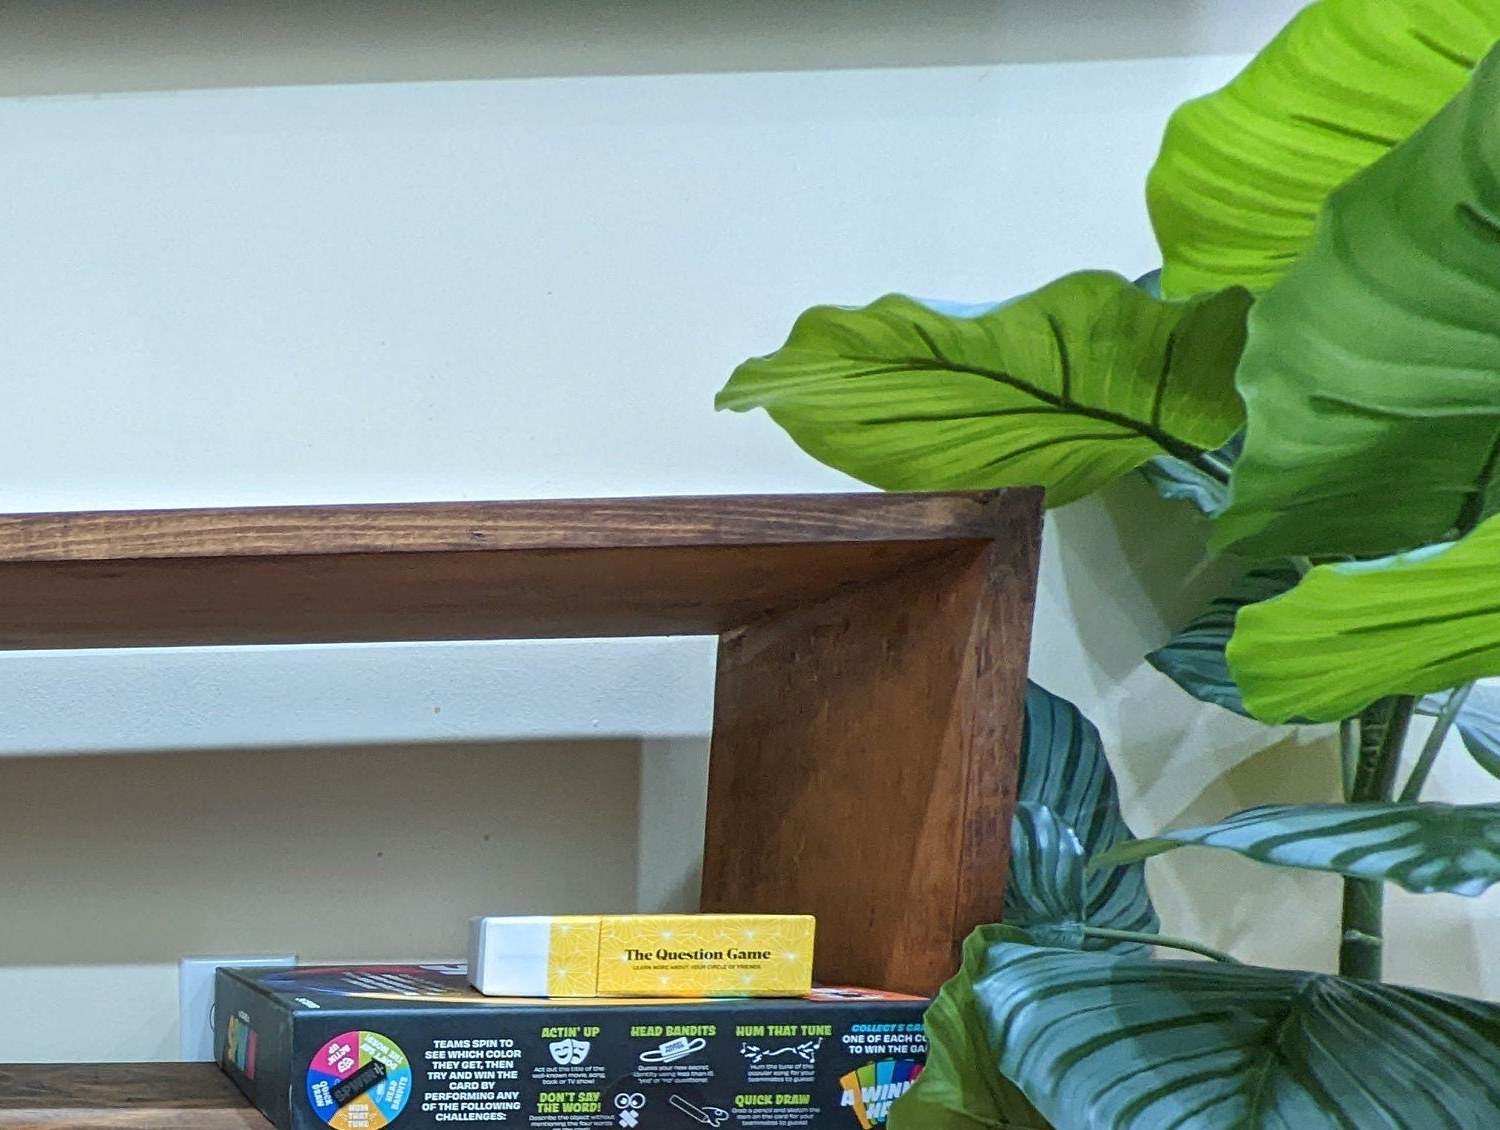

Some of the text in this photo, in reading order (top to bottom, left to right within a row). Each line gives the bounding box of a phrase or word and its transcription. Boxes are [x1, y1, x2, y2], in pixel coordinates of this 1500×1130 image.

[625, 947, 771, 961] The Question Game
[541, 1026, 600, 1038] ACTIN' UP
[630, 1025, 716, 1037] HEAD BANDITS
[735, 1025, 832, 1037] HUM THAT TUNE
[851, 1024, 896, 1032] COLLECT
[433, 1039, 514, 1048] TEAMS SPIN TO
[842, 1034, 865, 1043] ONE
[866, 1034, 882, 1043] OF
[883, 1034, 912, 1043] EACH
[328, 1043, 340, 1054] UP
[848, 1045, 928, 1054] TO WIN THE GA
[388, 1049, 404, 1064] THE
[424, 1050, 522, 1059] SEE WHICH COLOR
[432, 1060, 514, 1069] THEY GET, THEN
[427, 1070, 518, 1080] TRY AND WIN THE
[449, 1081, 496, 1090] CARD BY
[311, 1083, 325, 1107] DRAW
[319, 1081, 333, 1106] QUICK
[385, 1080, 398, 1103] HEAD
[424, 1092, 519, 1101] PERFORMING ANY
[540, 1092, 600, 1102] DON'T SAY
[734, 1094, 810, 1107] QUICK DRAW
[422, 1102, 521, 1111] OF THE FOLLOWING
[537, 1102, 601, 1113] THE WORD!
[435, 1112, 507, 1121] CHALLENGES:
[348, 1120, 369, 1128] TUNE
